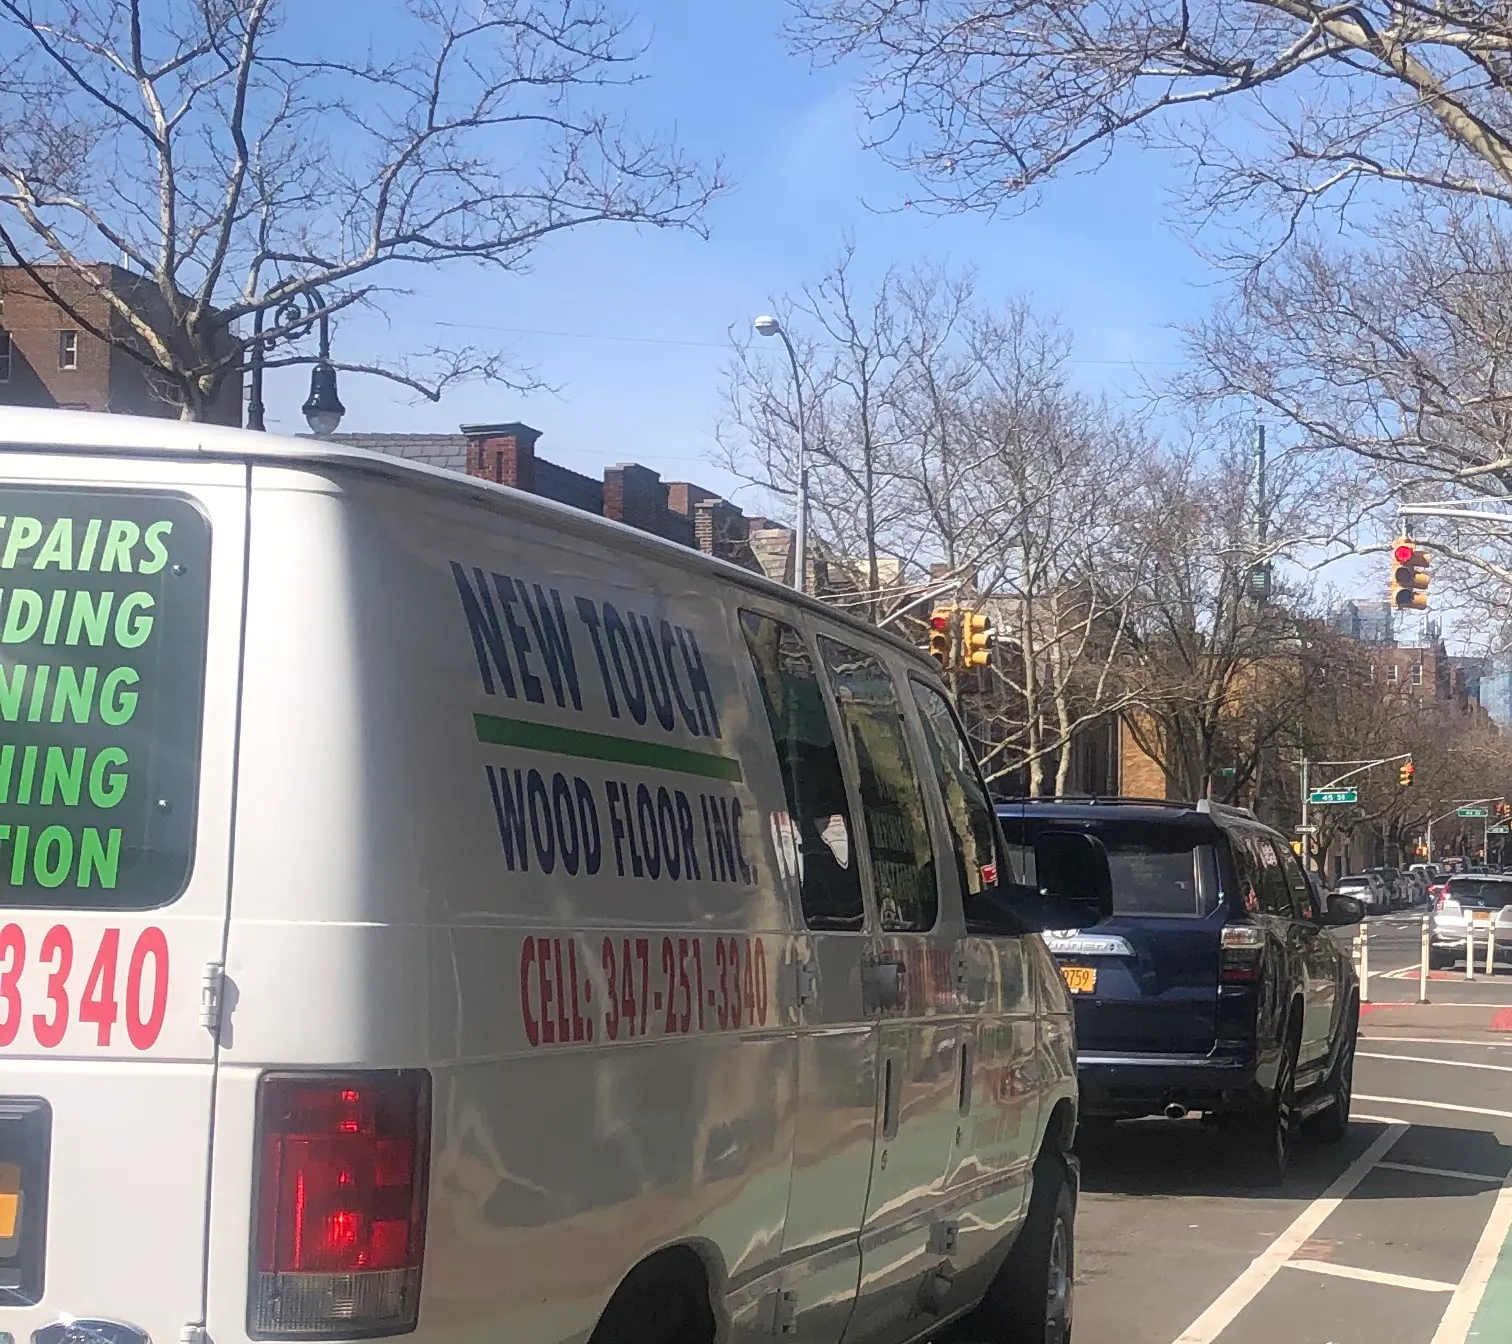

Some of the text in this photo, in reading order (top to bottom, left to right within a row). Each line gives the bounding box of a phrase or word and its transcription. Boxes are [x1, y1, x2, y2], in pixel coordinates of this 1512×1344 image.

[0, 516, 173, 574] PAIRS
[0, 587, 155, 649] DING
[450, 560, 722, 739] NEW TOUCH
[485, 765, 758, 885] WOOD FLOOR INC.
[520, 935, 767, 1047] CELL: 347-251-3340
